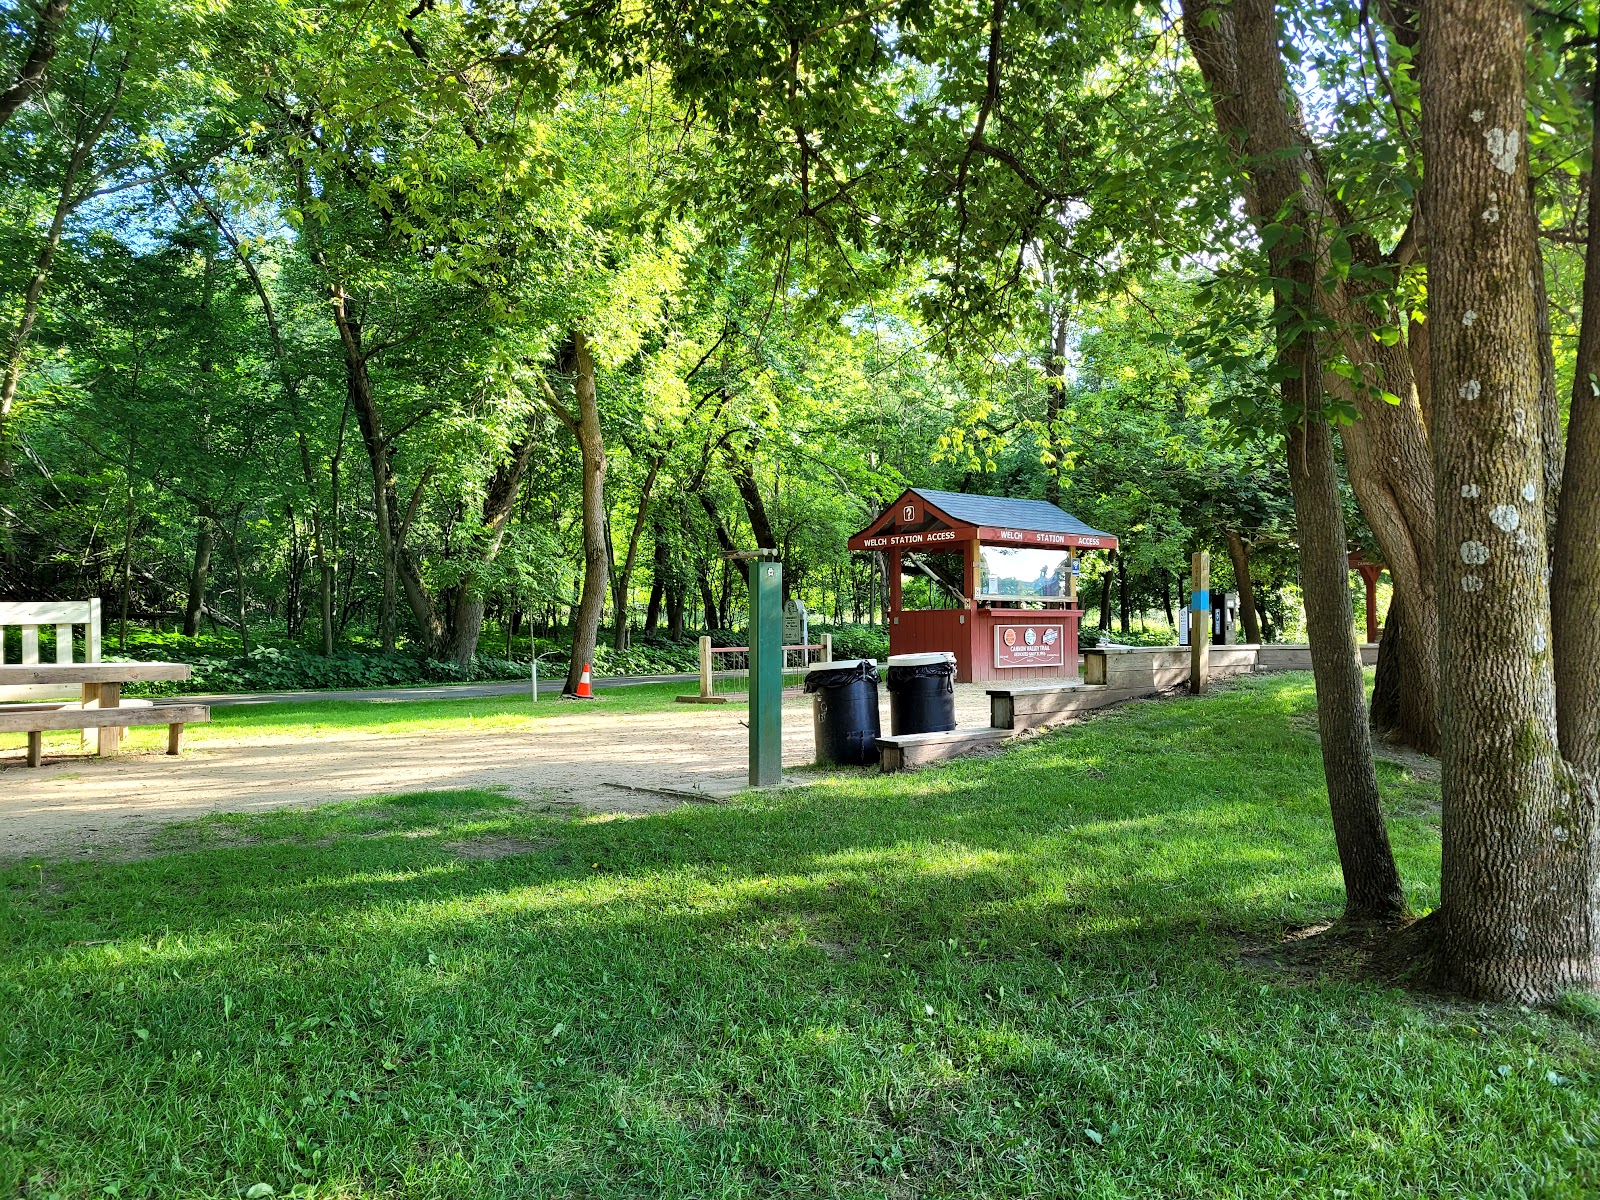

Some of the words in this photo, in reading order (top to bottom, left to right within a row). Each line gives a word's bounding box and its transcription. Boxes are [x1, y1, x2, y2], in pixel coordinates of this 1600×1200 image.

[864, 538, 886, 546] WELCH
[890, 534, 923, 544] STATION
[926, 532, 956, 541] ACCESS
[1000, 531, 1023, 540] WELCH
[1037, 534, 1064, 543] STATION
[1078, 538, 1100, 546] ACCESS
